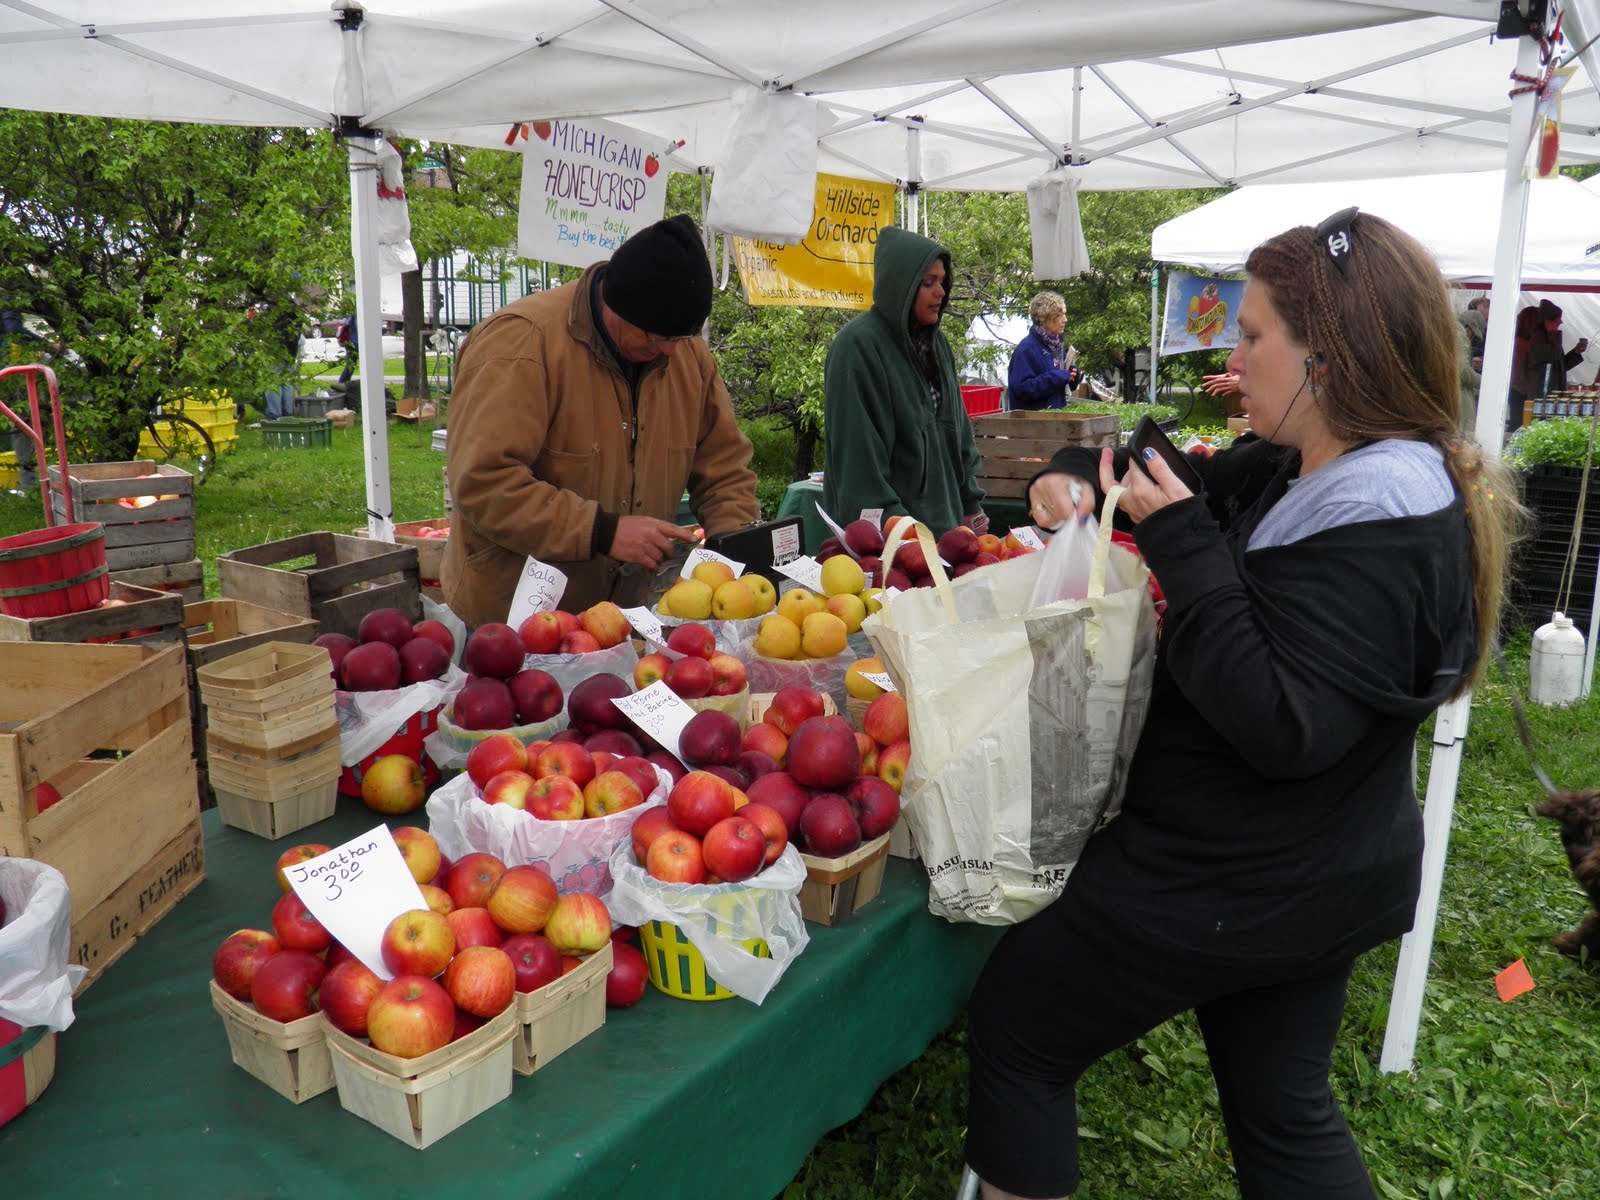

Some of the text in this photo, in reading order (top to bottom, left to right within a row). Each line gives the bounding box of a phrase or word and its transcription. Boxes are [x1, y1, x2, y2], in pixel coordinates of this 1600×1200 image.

[552, 120, 642, 171] MICHIGAN
[544, 159, 646, 213] HONEYCRISP
[825, 187, 880, 217] Hillside
[558, 224, 581, 248] Buy
[582, 229, 597, 245] the
[603, 216, 631, 240] tasty
[740, 251, 777, 275] Organic
[819, 288, 865, 303] Products
[527, 561, 555, 586] Gala
[631, 689, 660, 708] Rome
[644, 695, 680, 713] Baking
[292, 841, 378, 883] Jonathan
